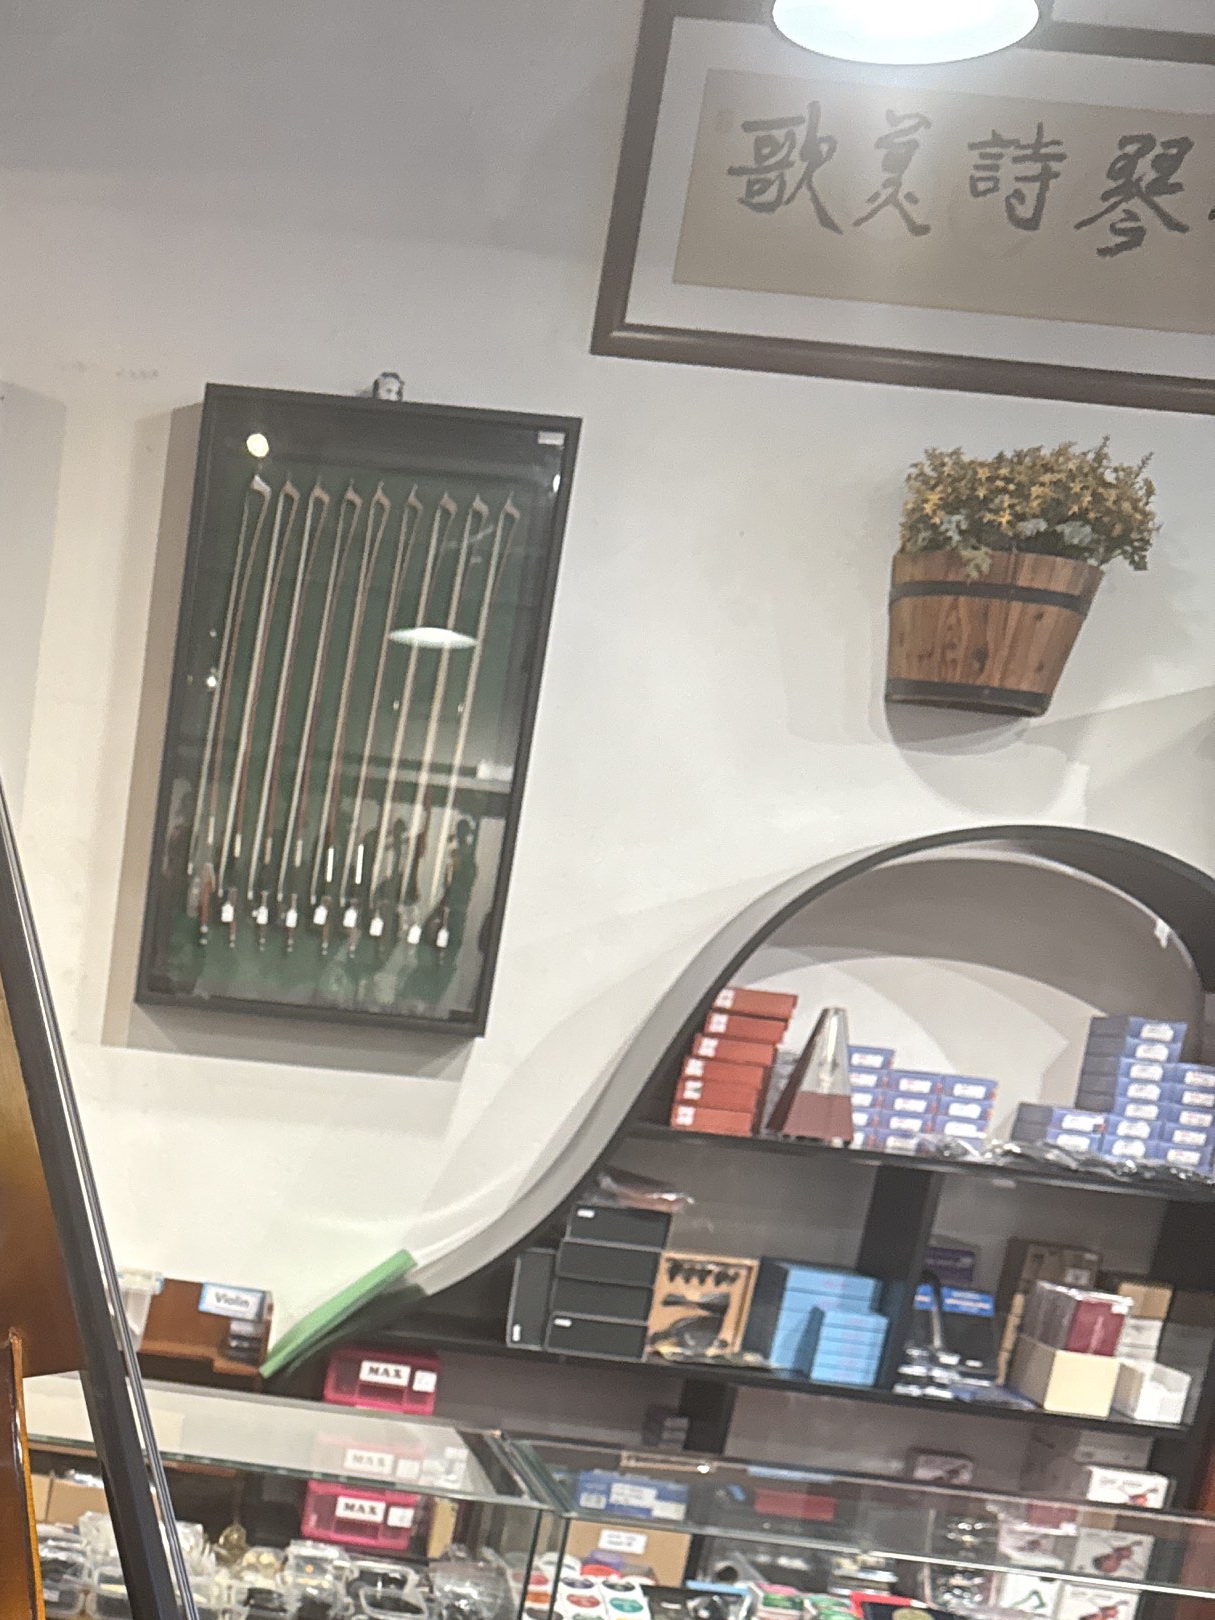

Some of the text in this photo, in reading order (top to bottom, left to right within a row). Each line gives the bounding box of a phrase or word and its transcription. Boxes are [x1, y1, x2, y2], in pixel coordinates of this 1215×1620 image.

[215, 1291, 250, 1308] Violin
[368, 1366, 403, 1380] MAX
[343, 1502, 378, 1515] MAX
